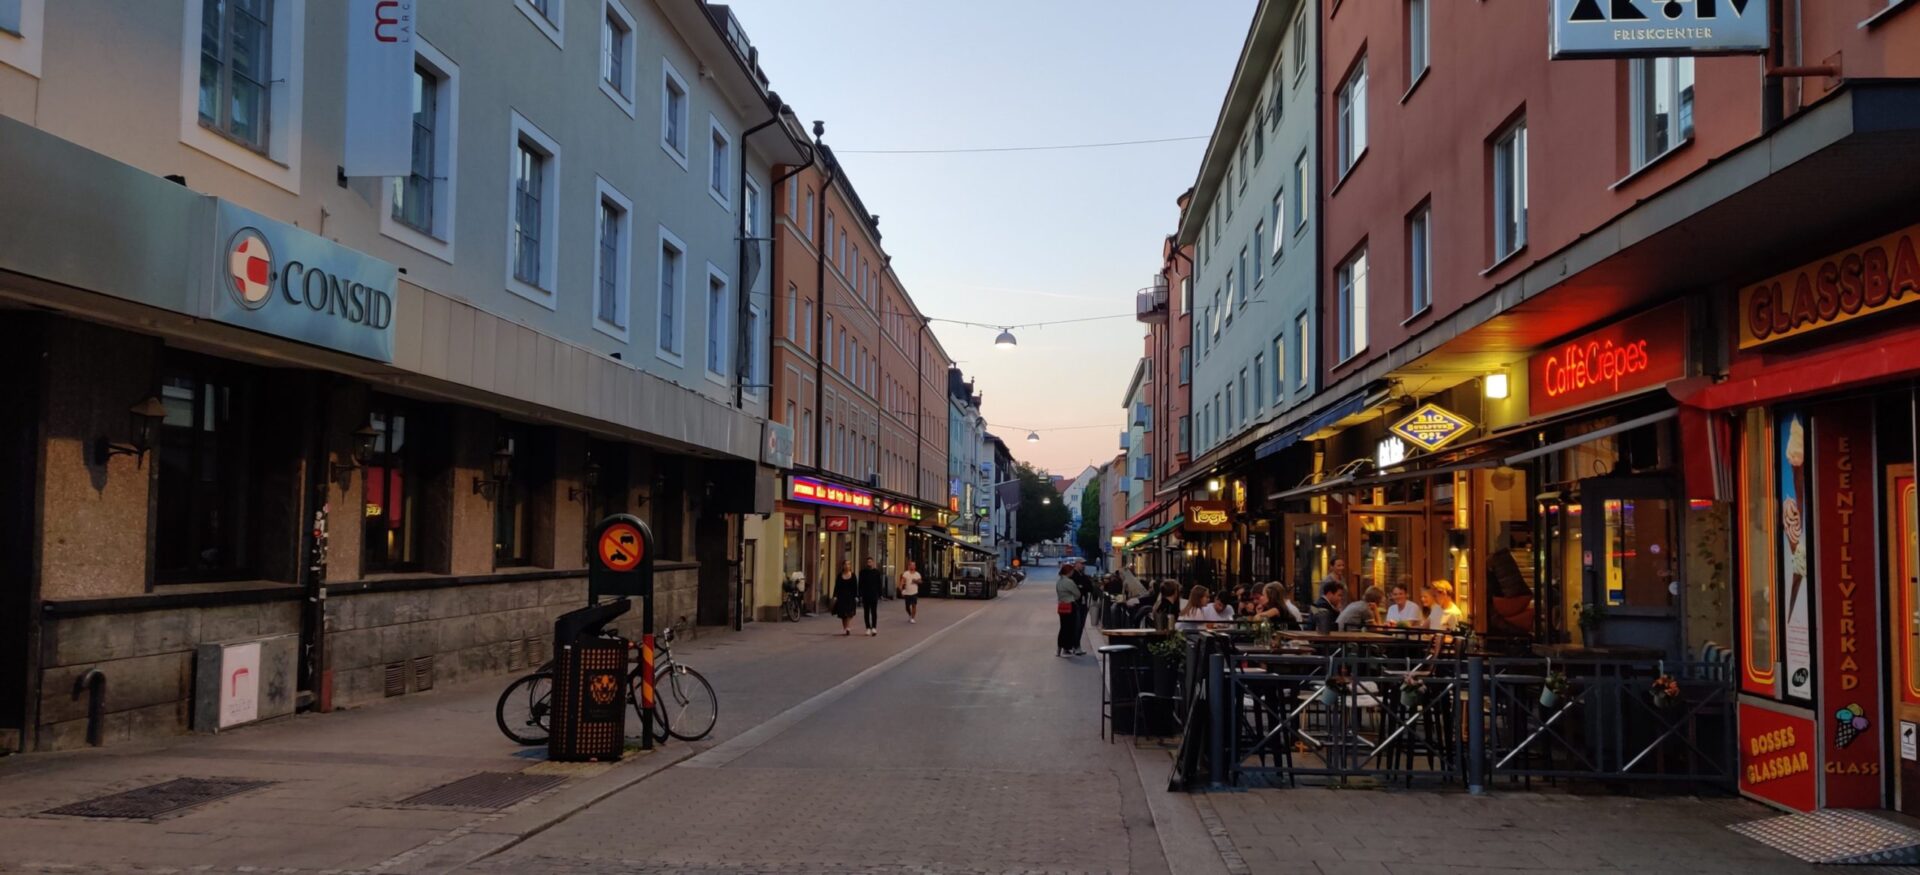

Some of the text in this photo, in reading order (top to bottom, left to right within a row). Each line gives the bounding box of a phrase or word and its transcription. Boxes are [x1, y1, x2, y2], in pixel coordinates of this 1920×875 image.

[1614, 28, 1712, 40] FRISKCENTER
[282, 261, 391, 330] CONSID
[1418, 415, 1444, 423] BIO
[1837, 436, 1860, 690] EGENTILLVERKAD
[1751, 726, 1796, 756] BOSSES
[1747, 751, 1808, 784] GLASSBAR
[1826, 762, 1879, 775] GLASS
